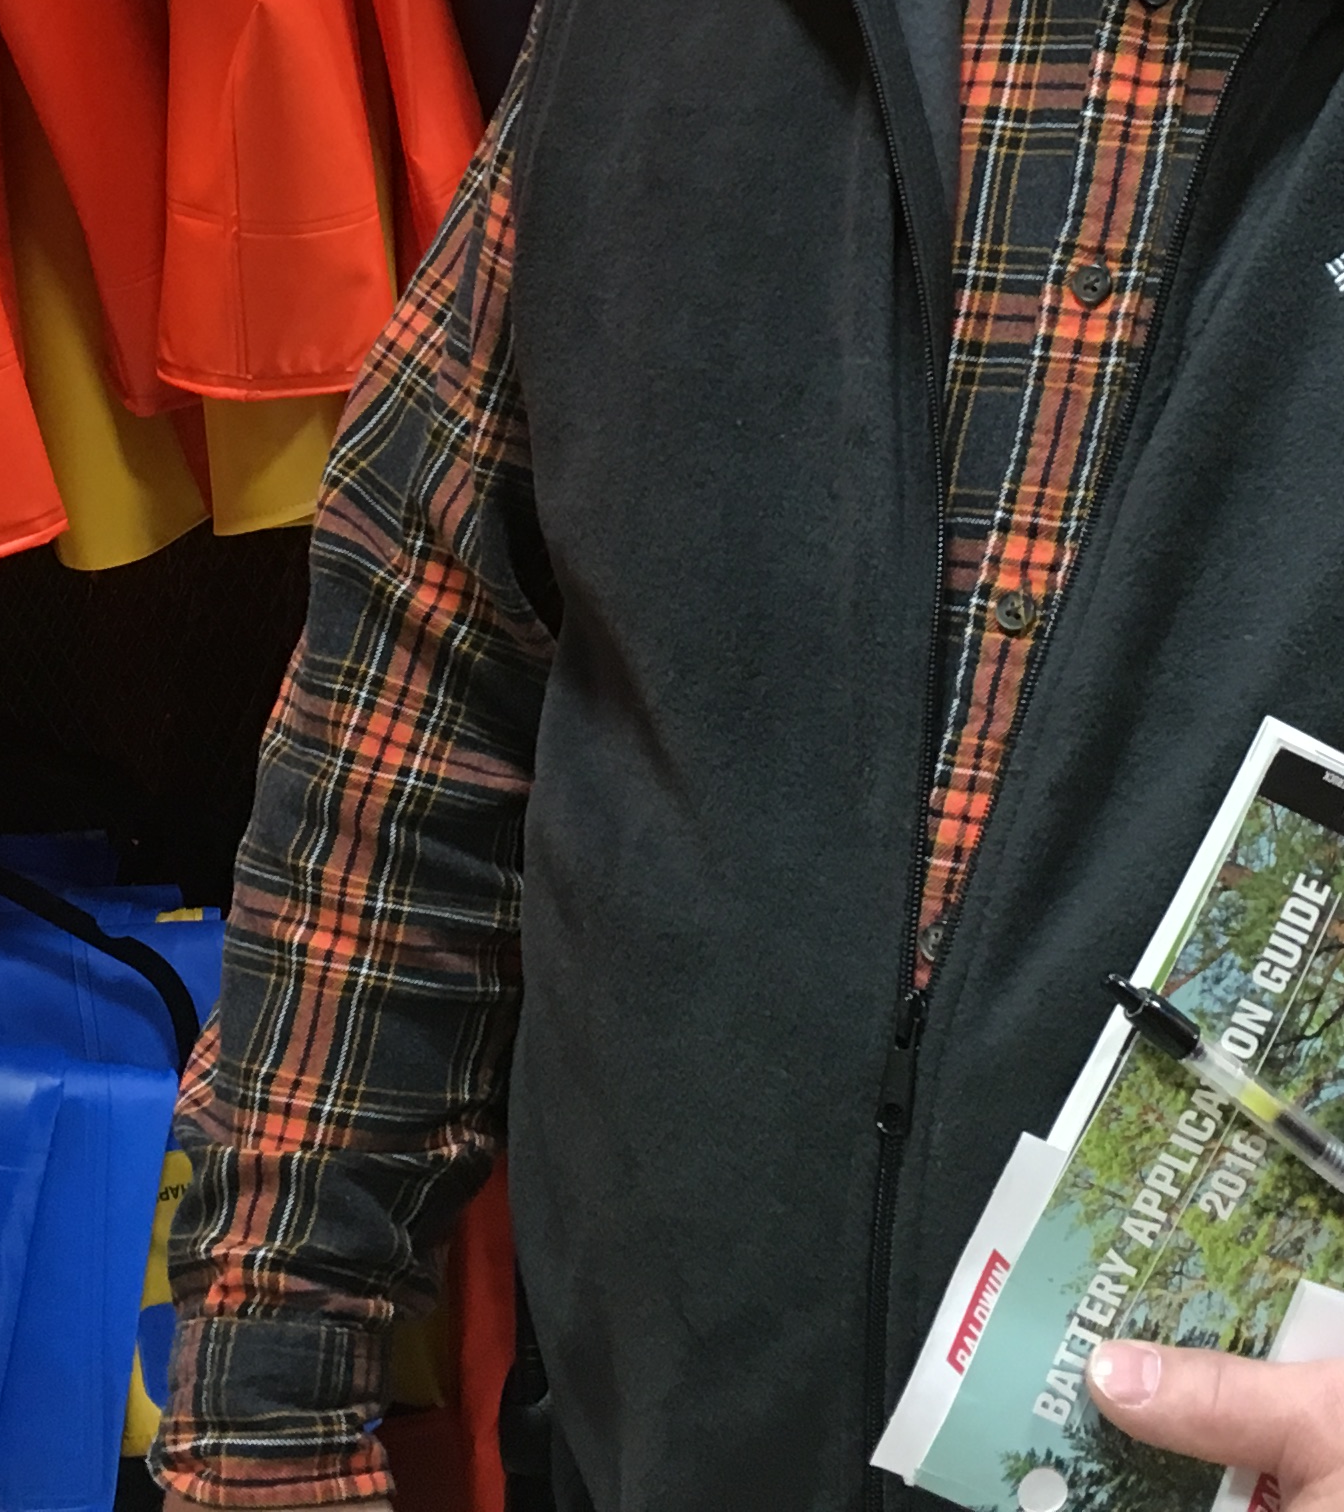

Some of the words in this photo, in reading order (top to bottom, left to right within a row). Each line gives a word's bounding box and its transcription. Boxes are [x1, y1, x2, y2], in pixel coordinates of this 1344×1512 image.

[1031, 1248, 1138, 1425] BATTERY
[1124, 1000, 1273, 1247] APPLICAON
[1253, 874, 1332, 994] GUIDE
[1200, 1128, 1268, 1222] 2016
